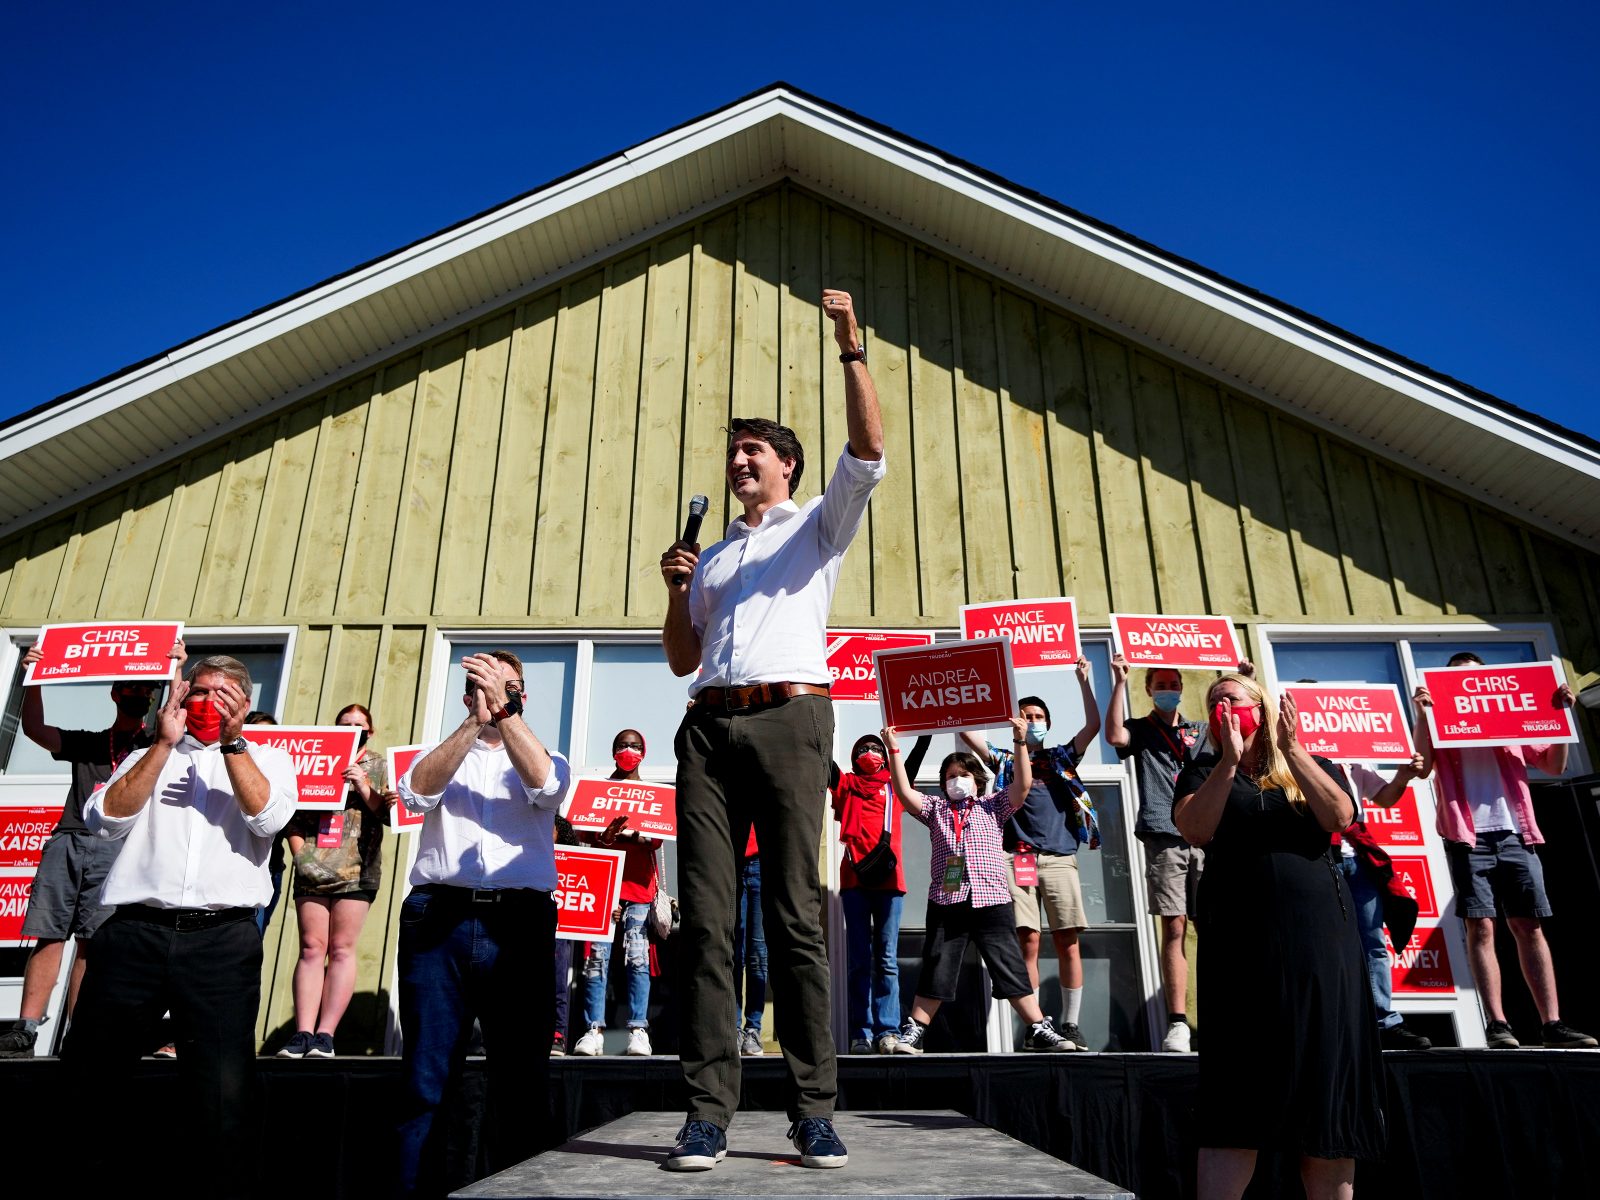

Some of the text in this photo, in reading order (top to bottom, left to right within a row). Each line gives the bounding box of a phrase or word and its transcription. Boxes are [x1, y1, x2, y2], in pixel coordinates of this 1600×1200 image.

[993, 610, 1045, 626] VANCE
[1145, 622, 1201, 633] VANCE
[82, 629, 140, 642] CHRIS
[1127, 631, 1223, 648] BADAWEY
[64, 642, 150, 659] BITTLE
[1130, 651, 1164, 660] Liberal
[41, 664, 81, 675] Liberal
[829, 666, 877, 681] BADA
[907, 667, 980, 689] ANDREA
[1462, 675, 1519, 693] CHRIS
[901, 683, 993, 710] KAISER
[1316, 696, 1371, 711] VANCE
[1454, 693, 1538, 714] BITTLE
[936, 718, 962, 727] Liberal
[1299, 711, 1393, 733] BADAWEY
[1444, 723, 1482, 735] Liberal
[1522, 724, 1561, 732] TRUDEAU
[1305, 742, 1339, 753] Liberal
[1371, 745, 1405, 753] TRUDEAU
[301, 788, 336, 796] TRUDEAU
[607, 786, 656, 801] CHRIS
[591, 796, 663, 816] BITTLE
[572, 814, 605, 824] Liberal
[1363, 808, 1403, 824] TTLE
[641, 822, 674, 831] TRUDEAU
